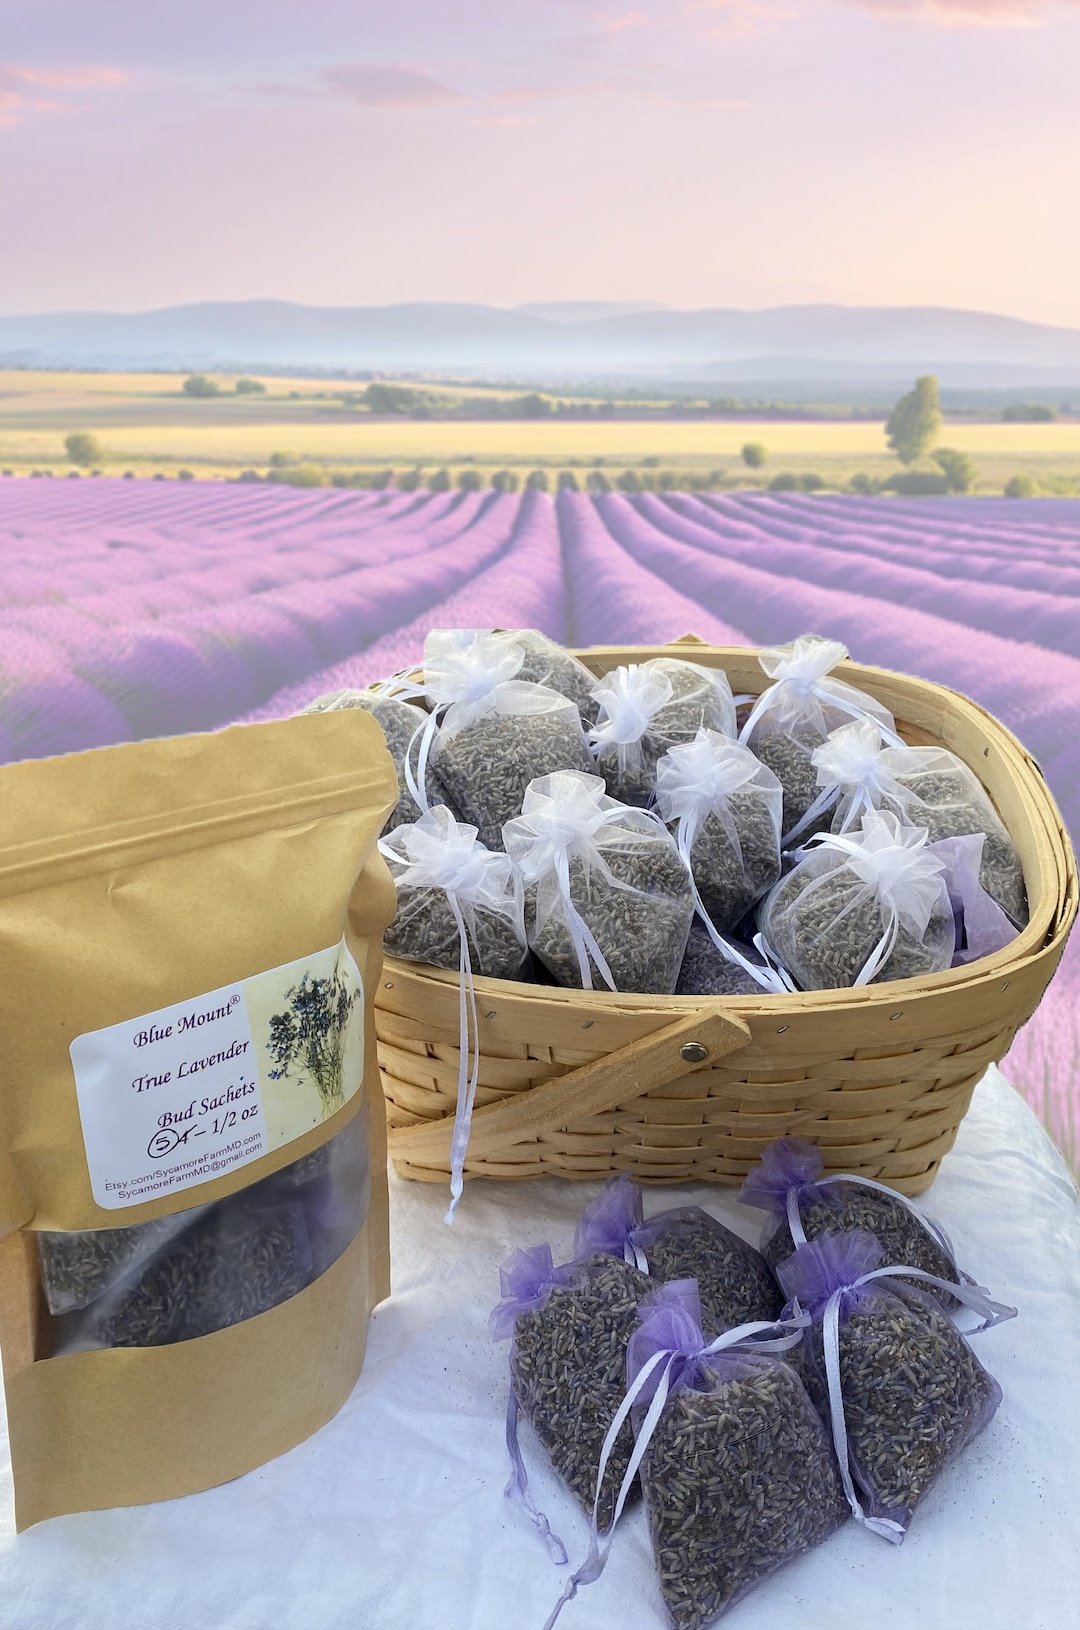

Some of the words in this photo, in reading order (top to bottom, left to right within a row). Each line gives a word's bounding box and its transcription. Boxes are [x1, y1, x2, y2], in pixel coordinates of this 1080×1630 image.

[133, 1023, 173, 1048] Blue
[131, 1071, 171, 1094] True
[177, 1040, 250, 1079] Lavender
[157, 1100, 195, 1129] Bud
[198, 1080, 256, 1116] Sachets
[211, 1111, 237, 1135] 1/2
[241, 1104, 259, 1120] oz
[105, 1131, 261, 1192] Etsy.com/SycamoreFarmMD.com
[118, 1142, 263, 1199] SycamoreFarmMD@gmail.com
